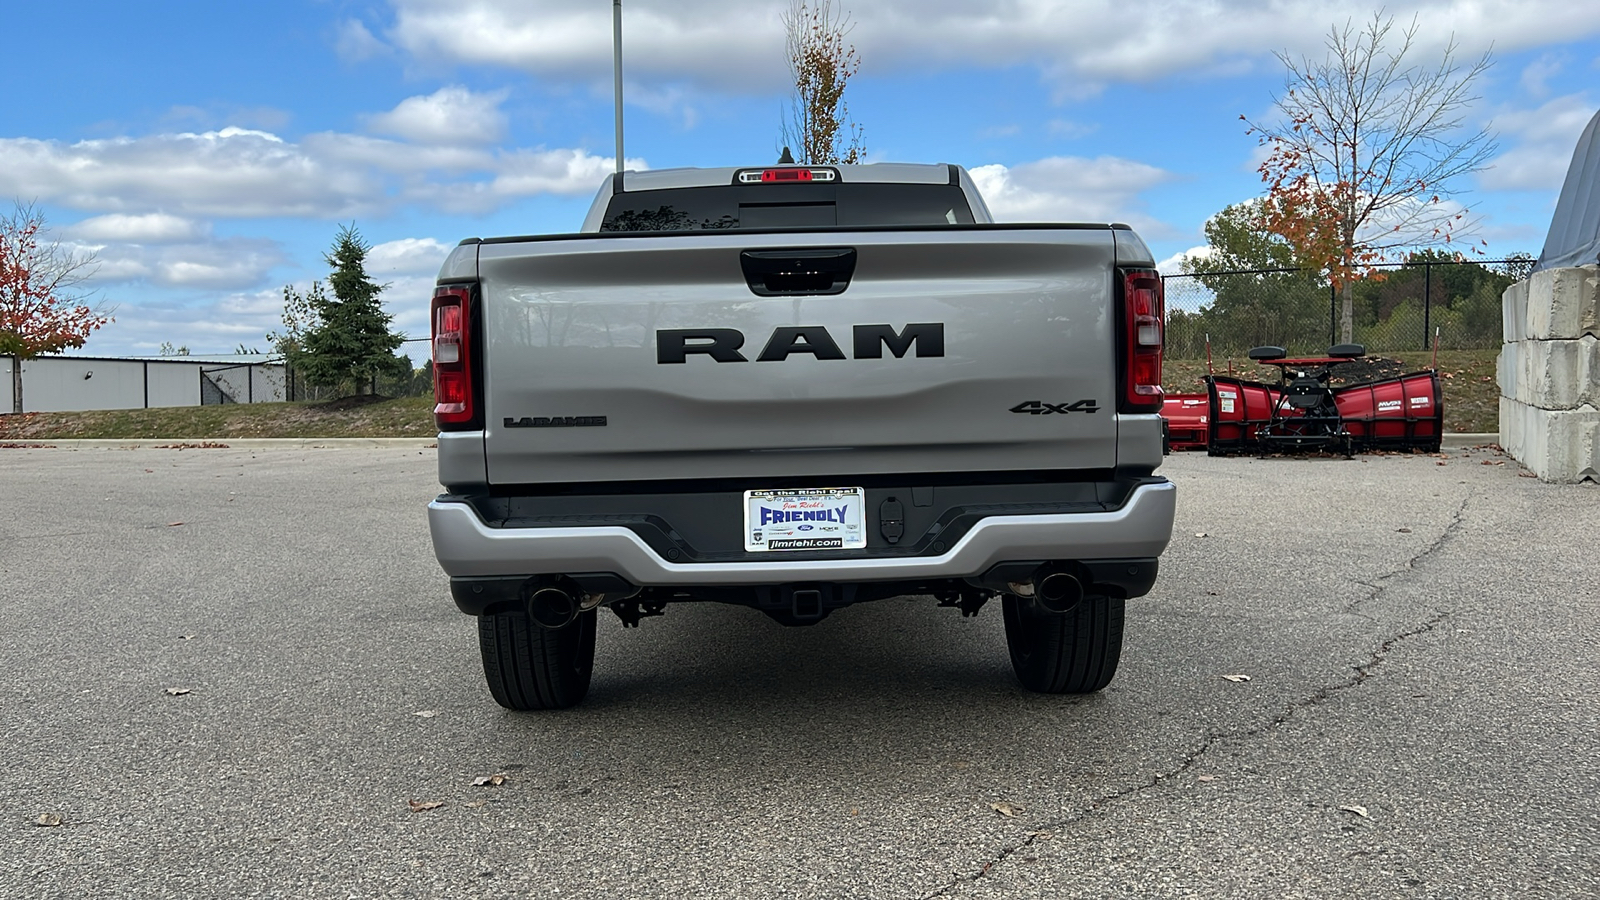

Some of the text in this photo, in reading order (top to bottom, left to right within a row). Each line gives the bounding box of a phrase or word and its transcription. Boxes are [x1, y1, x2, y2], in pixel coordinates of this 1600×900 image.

[656, 322, 945, 364] RAM
[1008, 399, 1101, 415] 4x4
[503, 415, 608, 428] LARAMIE
[782, 501, 825, 511] Jim Riehl's
[760, 504, 848, 526] FRIENDLY
[770, 539, 841, 549] jimriehl.com
